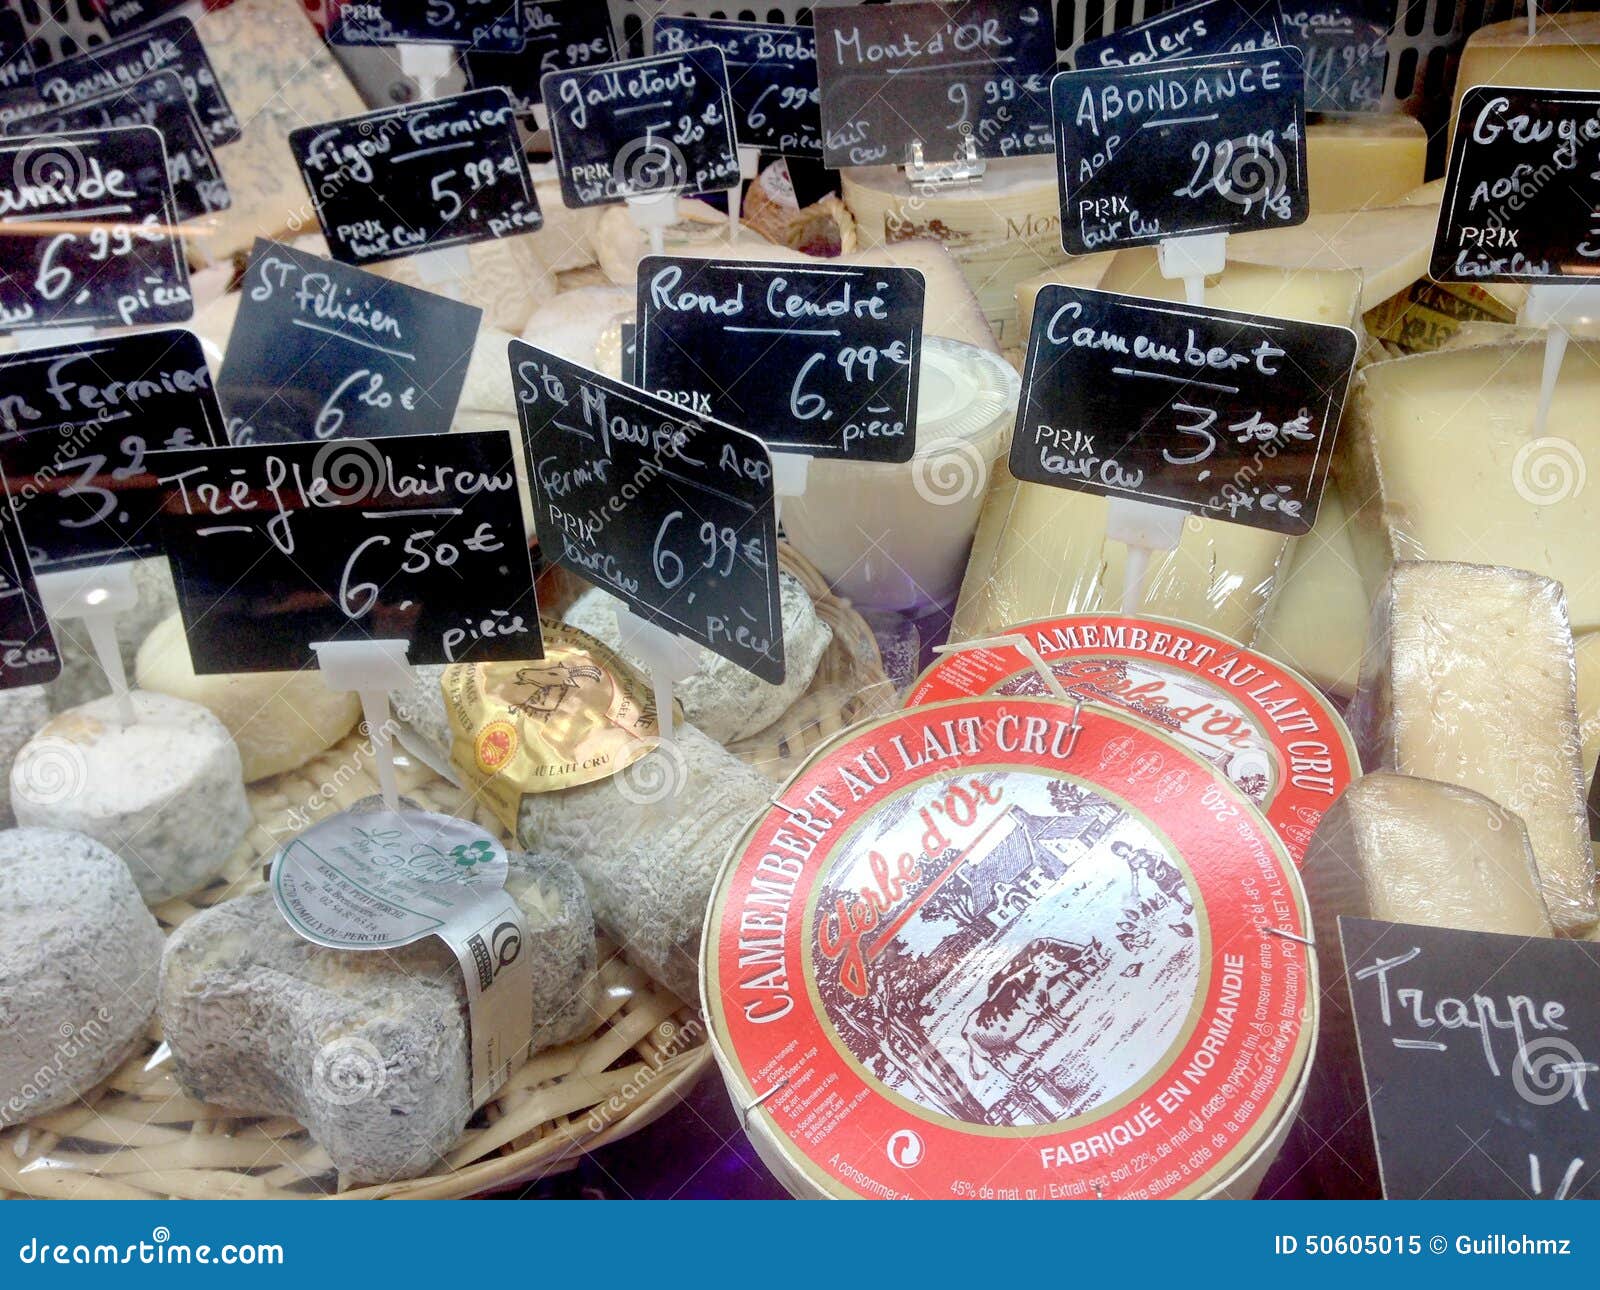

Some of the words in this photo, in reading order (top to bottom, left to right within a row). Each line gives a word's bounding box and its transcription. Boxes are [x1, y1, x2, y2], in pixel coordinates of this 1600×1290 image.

[1075, 60, 1281, 136] ABONDANCE
[571, 163, 612, 180] PRIX
[1079, 196, 1131, 219] PRIX
[336, 219, 386, 243] PRIX
[1458, 226, 1520, 248] PRIX
[650, 265, 744, 318] Rond
[1045, 301, 1286, 377] Camembert
[1034, 424, 1097, 457] PRIX
[1036, 625, 1216, 667] AMEMBERT
[1208, 649, 1257, 689] AU
[1247, 680, 1319, 737] LAIT
[1285, 739, 1337, 797] CRU
[737, 787, 846, 1026] CAMEMBERT
[837, 744, 891, 802] AU
[888, 715, 982, 772] LAIT
[996, 715, 1082, 760] CRU
[1273, 900, 1292, 922] NET
[1280, 923, 1297, 958] POIS
[1259, 943, 1273, 969] entre
[1254, 968, 1273, 1021] conserver
[1355, 946, 1568, 1077] Trappe
[1039, 1102, 1163, 1169] FABRIQUÉ
[1157, 1079, 1193, 1115] EN
[1182, 952, 1245, 1087] NORMANDIE
[1132, 1150, 1158, 1173] 22%
[950, 1179, 976, 1198] 45%
[978, 1183, 994, 1199] de
[1049, 1180, 1088, 1199] Extrait
